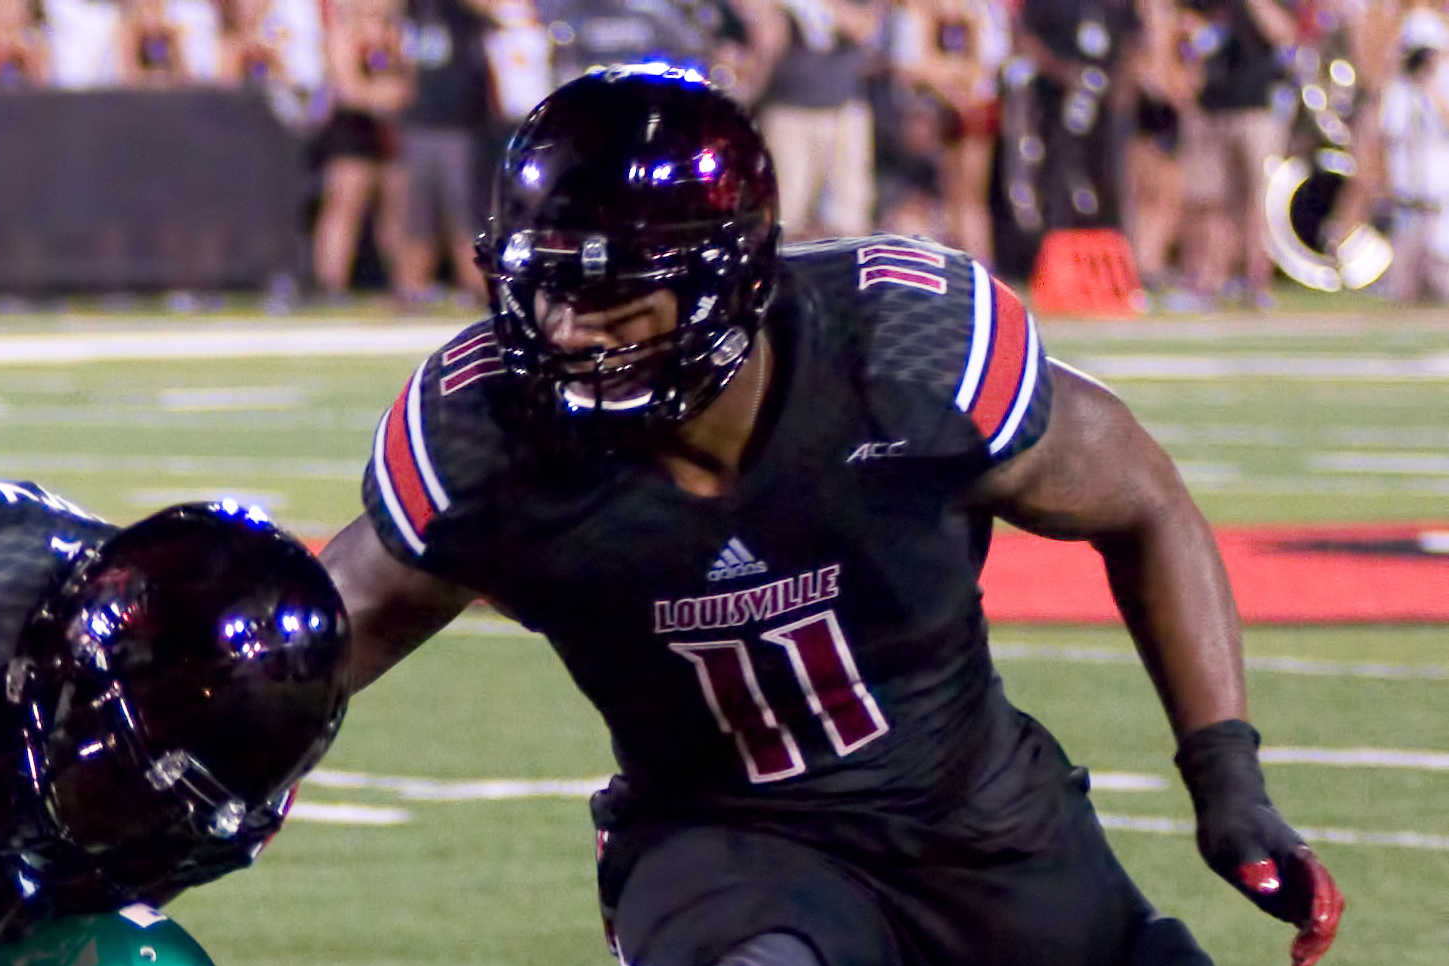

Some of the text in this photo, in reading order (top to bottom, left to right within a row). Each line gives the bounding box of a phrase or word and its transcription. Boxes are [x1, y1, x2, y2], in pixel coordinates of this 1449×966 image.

[845, 440, 907, 462] ACC
[707, 561, 768, 581] adidas
[653, 564, 840, 634] LOUISVILLE
[668, 609, 890, 785] 11
